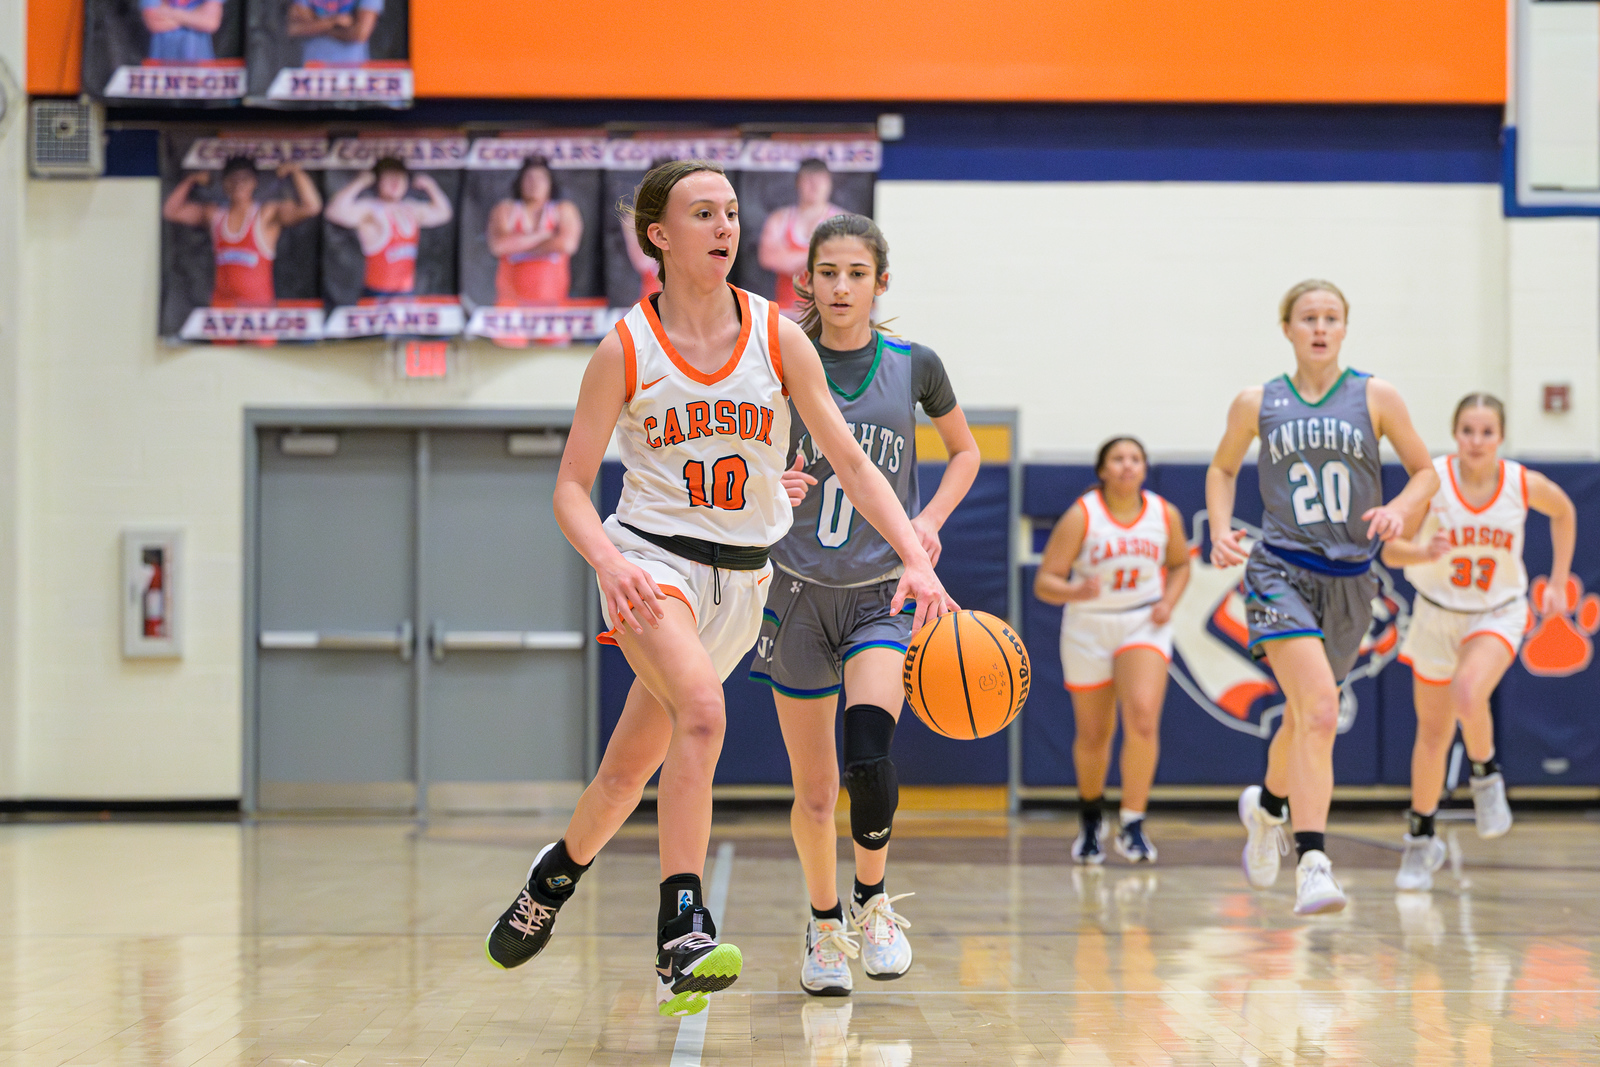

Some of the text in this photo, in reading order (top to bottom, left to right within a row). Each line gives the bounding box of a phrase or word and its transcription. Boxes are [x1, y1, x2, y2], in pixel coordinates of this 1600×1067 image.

[643, 399, 774, 448] CARSON
[1267, 416, 1364, 465] KNIGHTS
[682, 453, 749, 511] 10
[1287, 460, 1352, 527] 20
[816, 472, 857, 550] 0
[1449, 526, 1514, 553] ARSON
[1111, 568, 1140, 591] 11
[1450, 556, 1497, 593] 33
